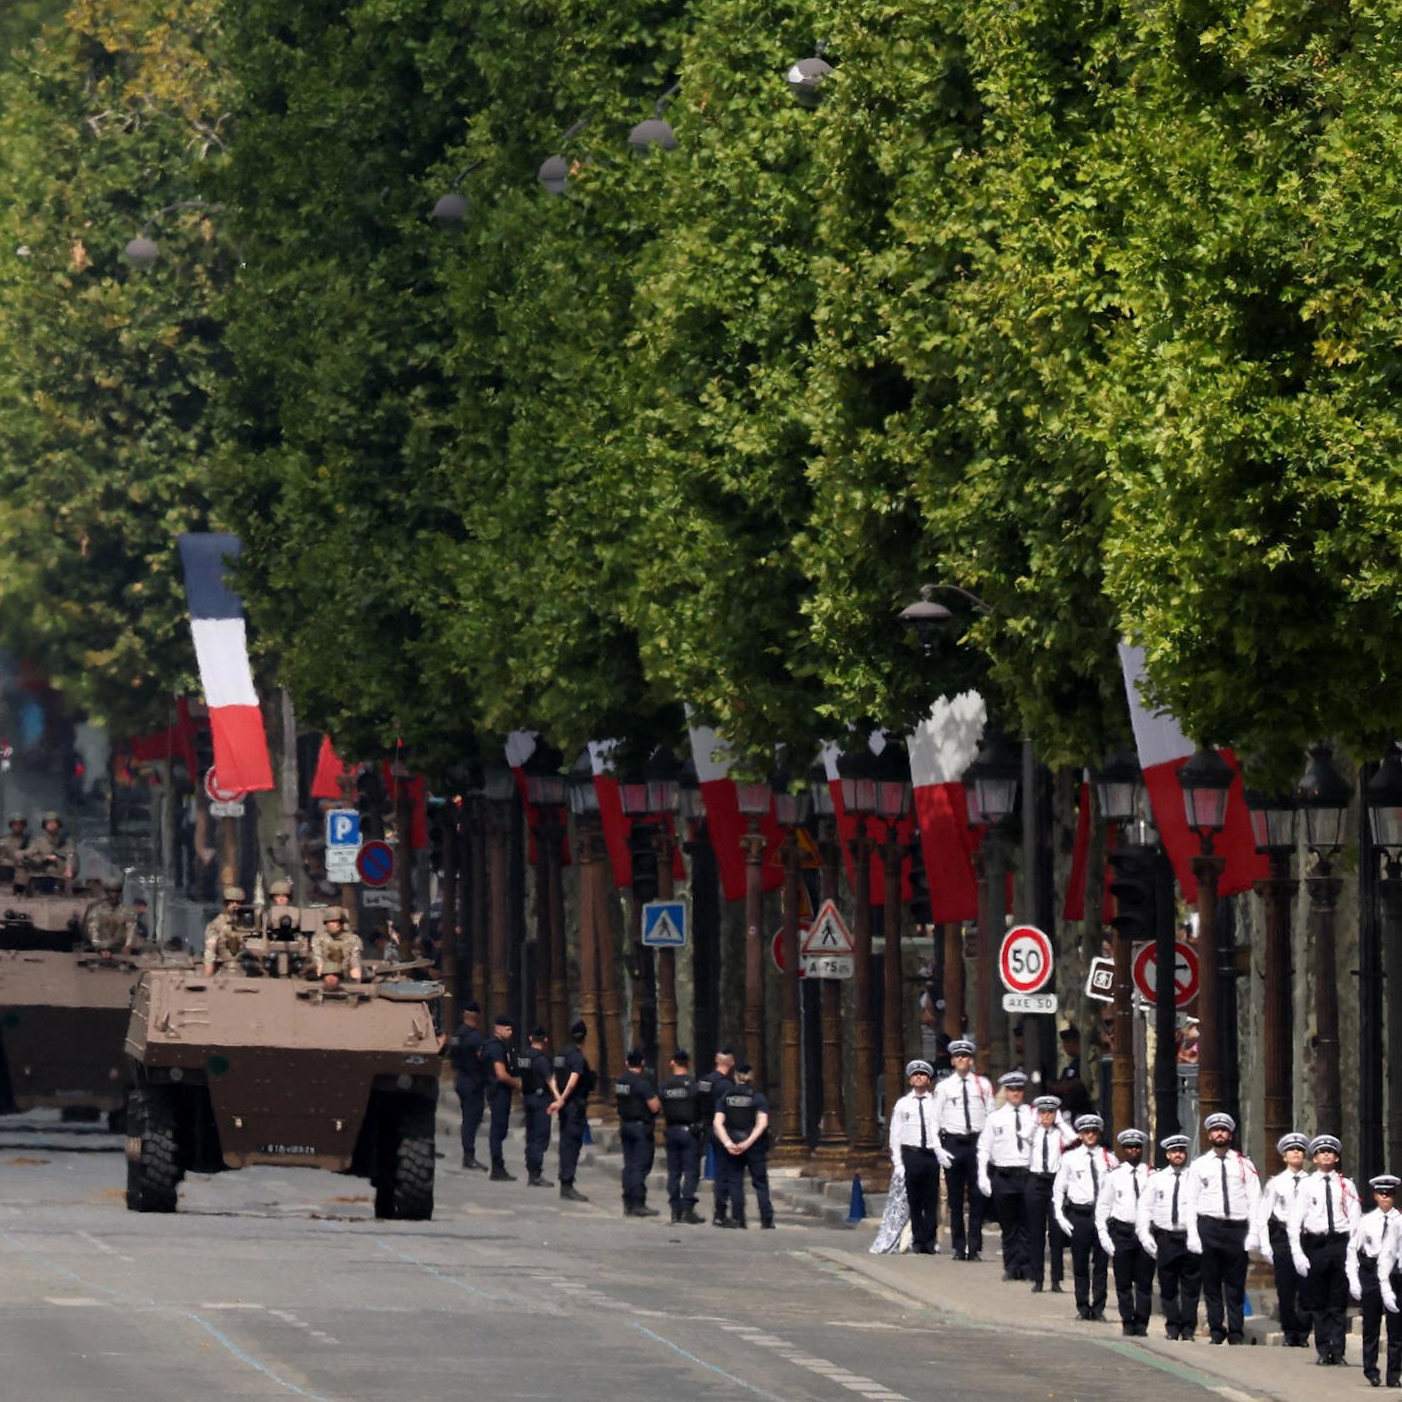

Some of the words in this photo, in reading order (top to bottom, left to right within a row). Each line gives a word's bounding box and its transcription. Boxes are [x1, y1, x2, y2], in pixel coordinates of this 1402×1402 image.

[337, 816, 352, 840] P
[1012, 949, 1040, 974] 50
[1009, 998, 1030, 1008] AXE
[1037, 998, 1053, 1009] 50
